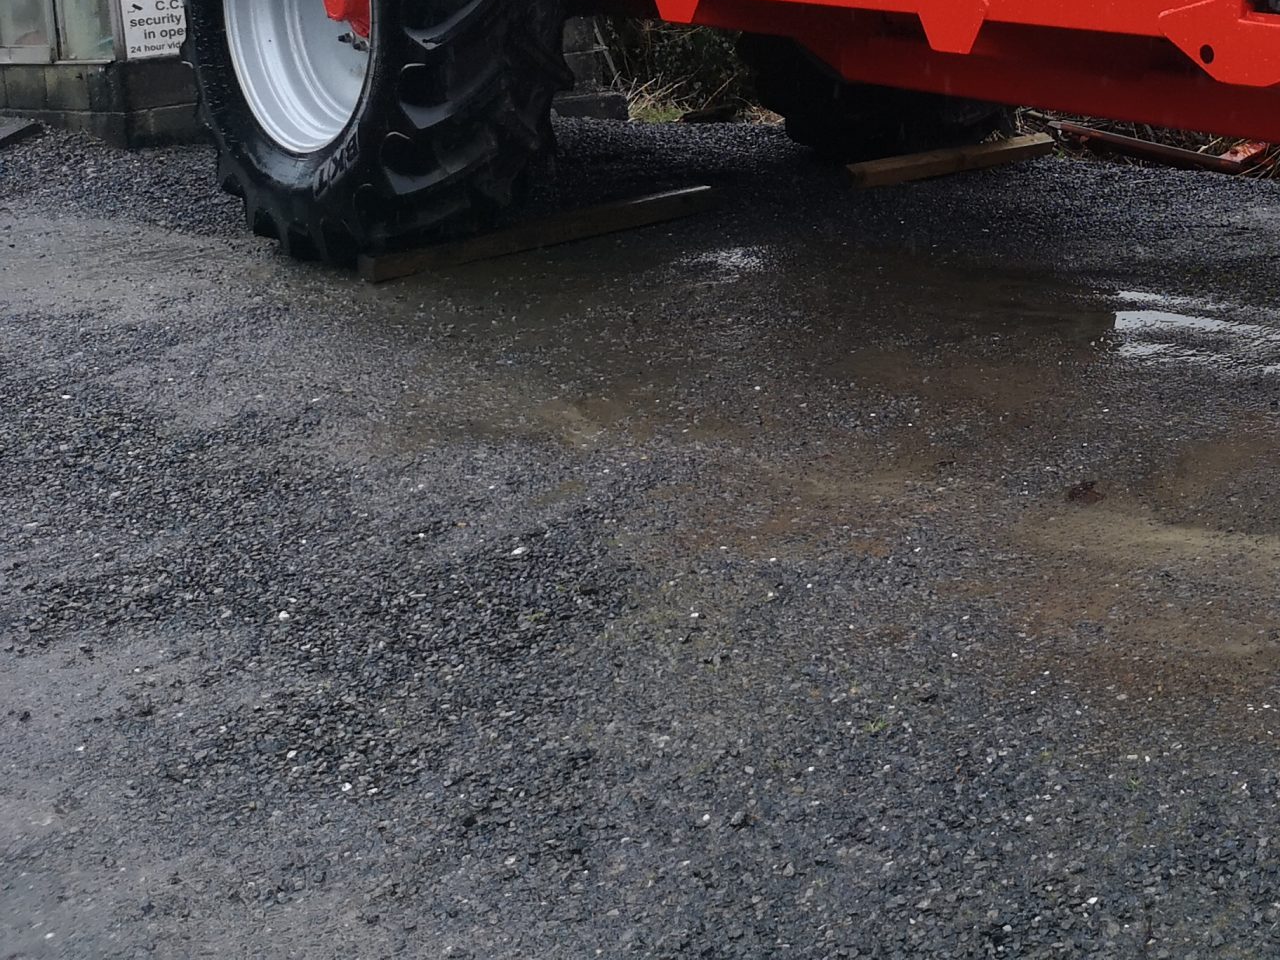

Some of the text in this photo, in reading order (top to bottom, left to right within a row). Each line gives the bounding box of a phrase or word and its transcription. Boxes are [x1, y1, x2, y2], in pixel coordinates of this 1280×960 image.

[129, 13, 182, 28] security
[143, 28, 156, 39] in
[130, 45, 142, 54] 24
[144, 43, 165, 52] hour
